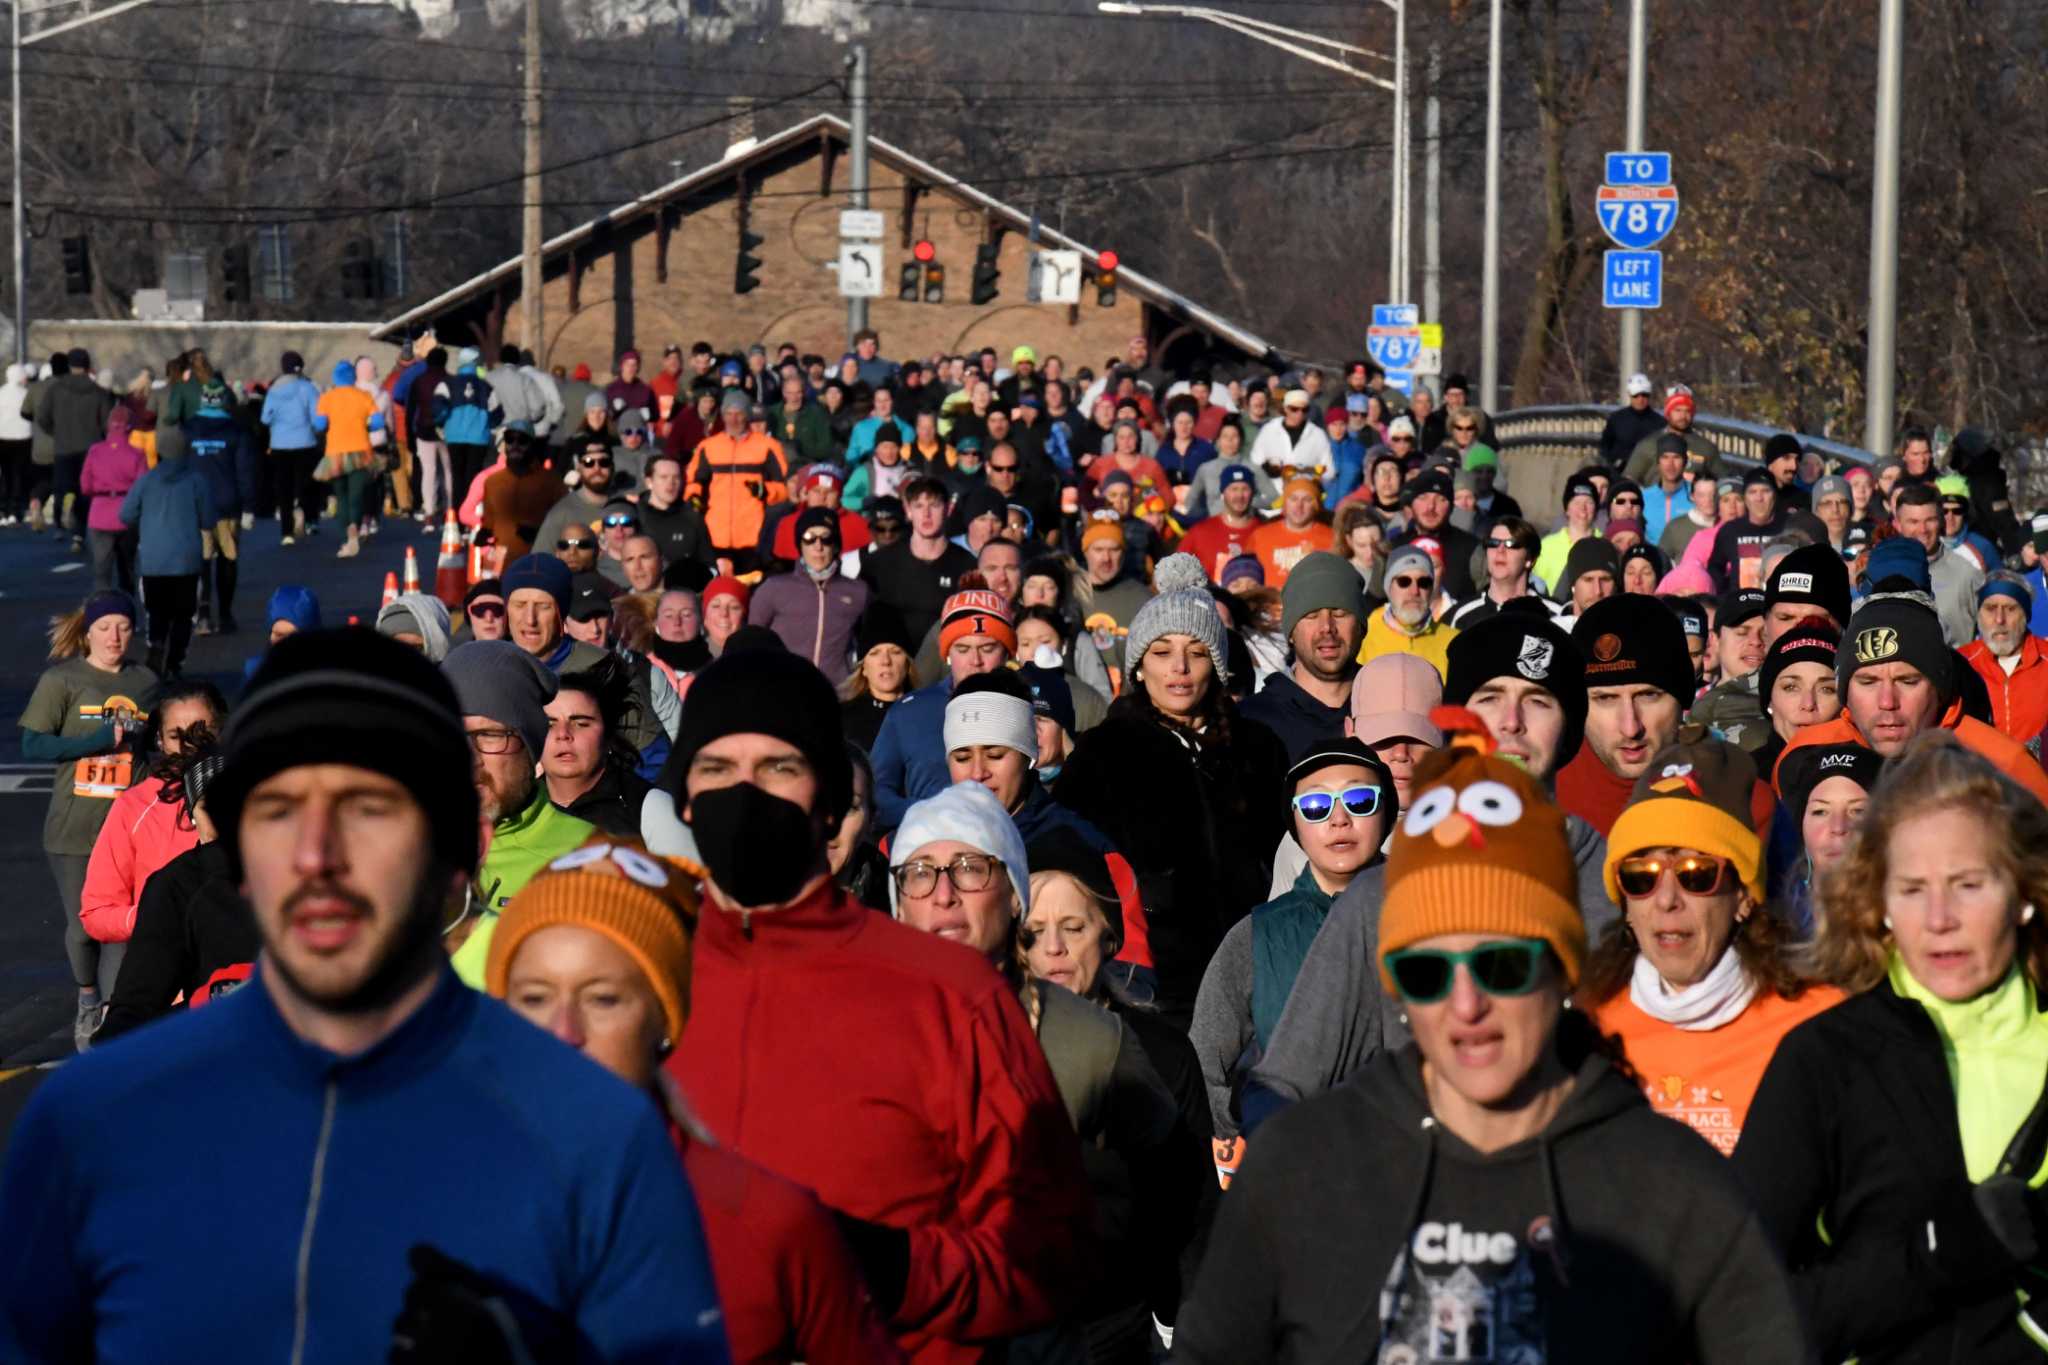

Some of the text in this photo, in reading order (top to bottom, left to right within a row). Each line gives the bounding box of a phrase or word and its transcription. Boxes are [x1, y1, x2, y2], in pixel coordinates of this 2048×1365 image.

[1622, 159, 1654, 179] TO
[1603, 203, 1671, 234] 787
[1614, 259, 1650, 277] LEFT
[1612, 281, 1651, 298] LANE
[1370, 335, 1419, 360] 787
[1780, 576, 1811, 586] SHRED
[1820, 754, 1857, 767] MVP
[87, 764, 117, 783] 511
[1688, 1111, 1733, 1128] RACE
[1412, 1222, 1517, 1265] Clue
